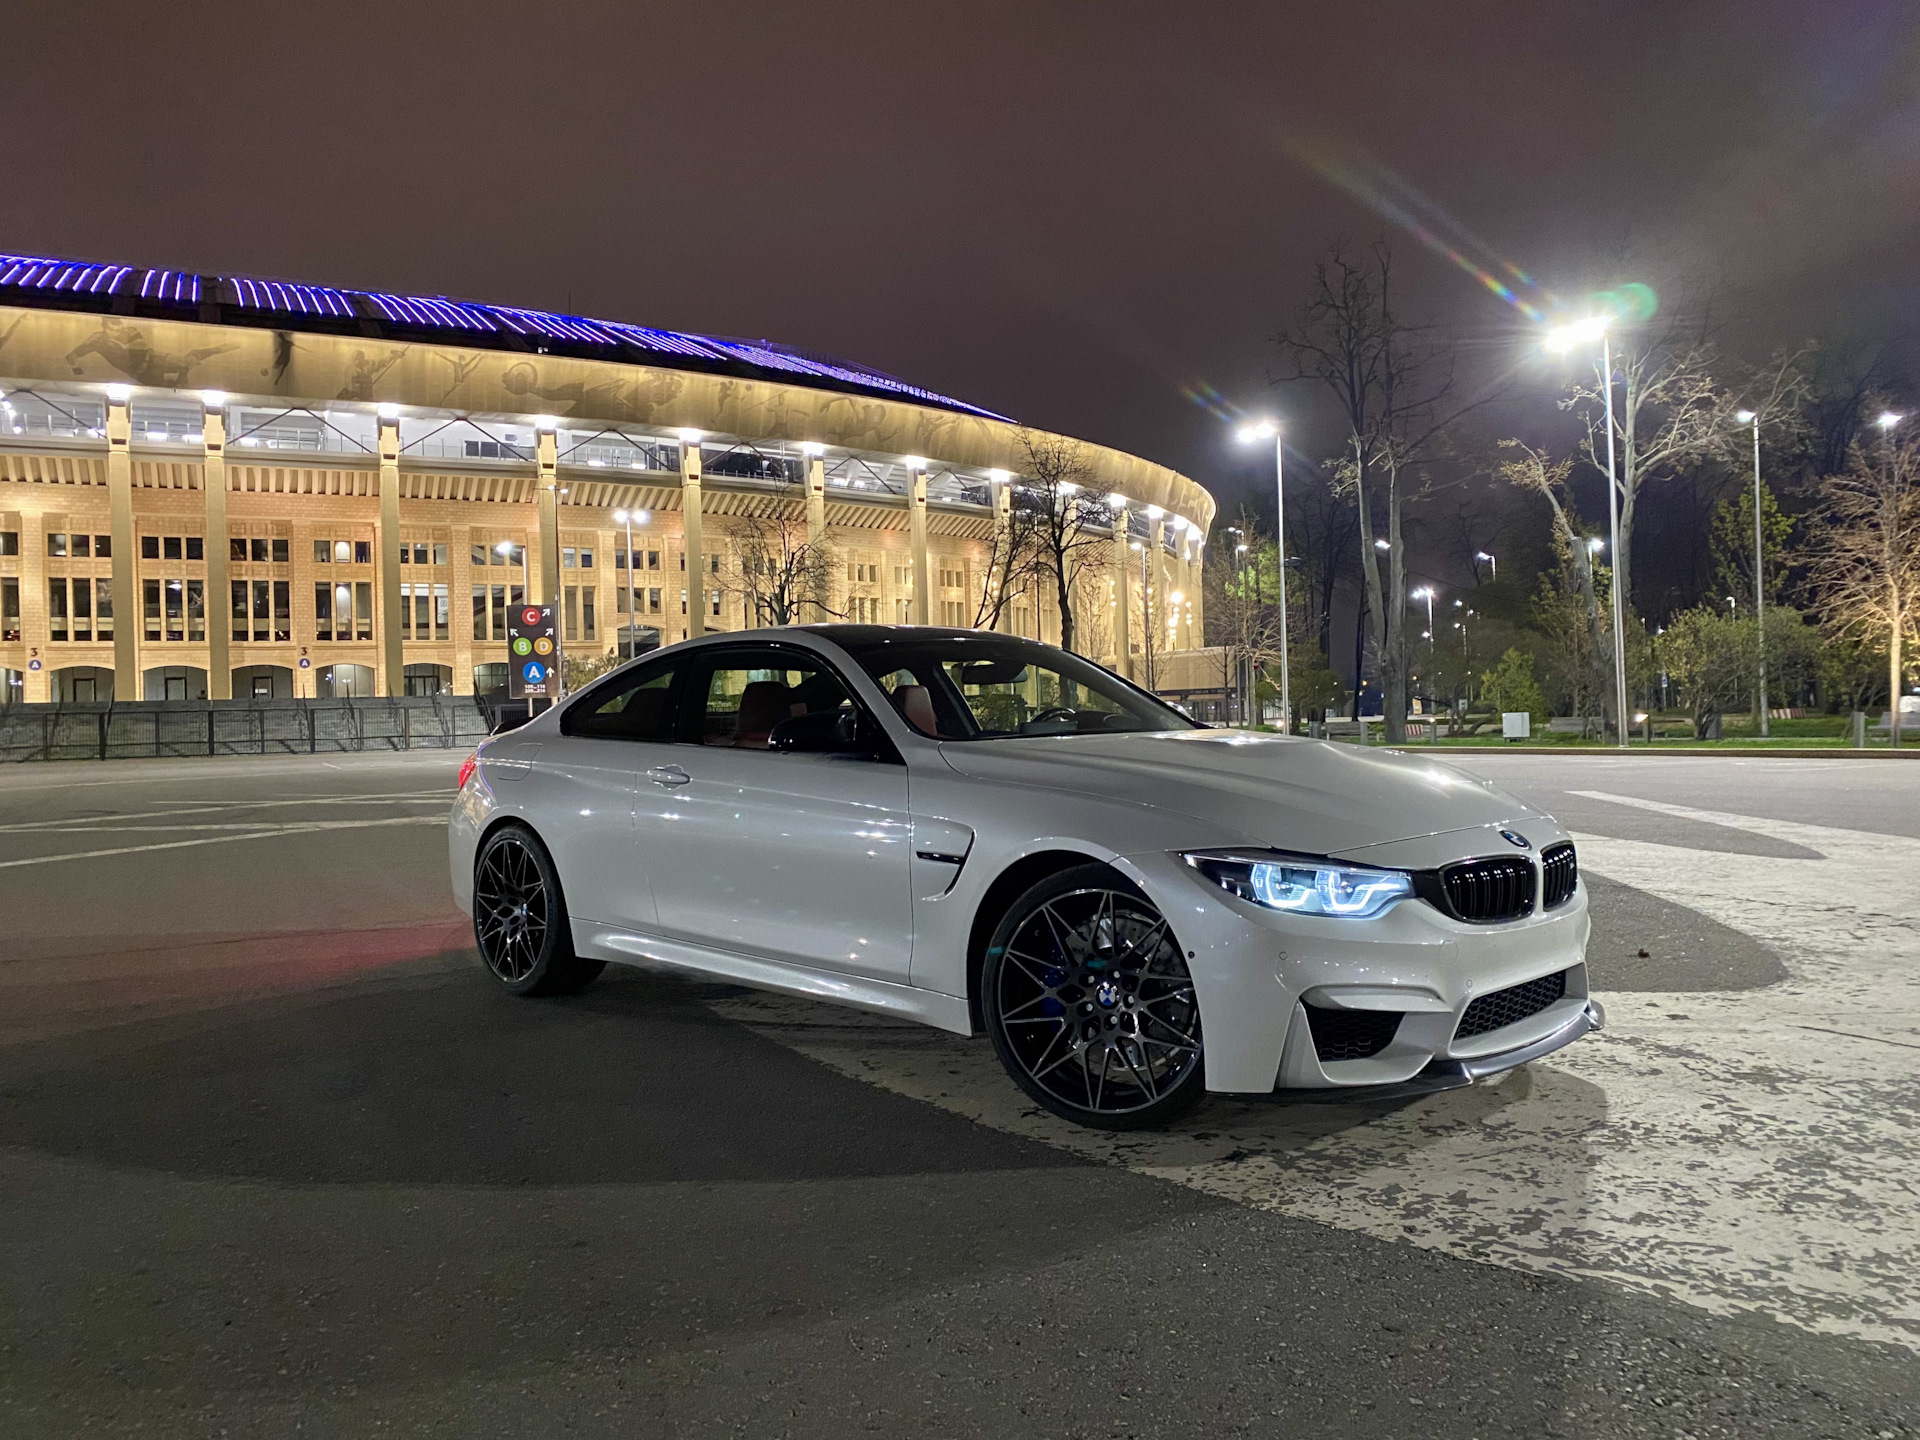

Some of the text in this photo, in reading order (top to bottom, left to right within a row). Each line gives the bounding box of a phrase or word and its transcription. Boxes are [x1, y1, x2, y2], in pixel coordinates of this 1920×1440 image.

[526, 611, 536, 622] C
[300, 646, 308, 656] 3
[518, 641, 528, 652] B
[539, 641, 549, 652] D
[30, 647, 38, 657] 3
[31, 660, 40, 669] A
[300, 659, 309, 667] A
[528, 665, 541, 679] A
